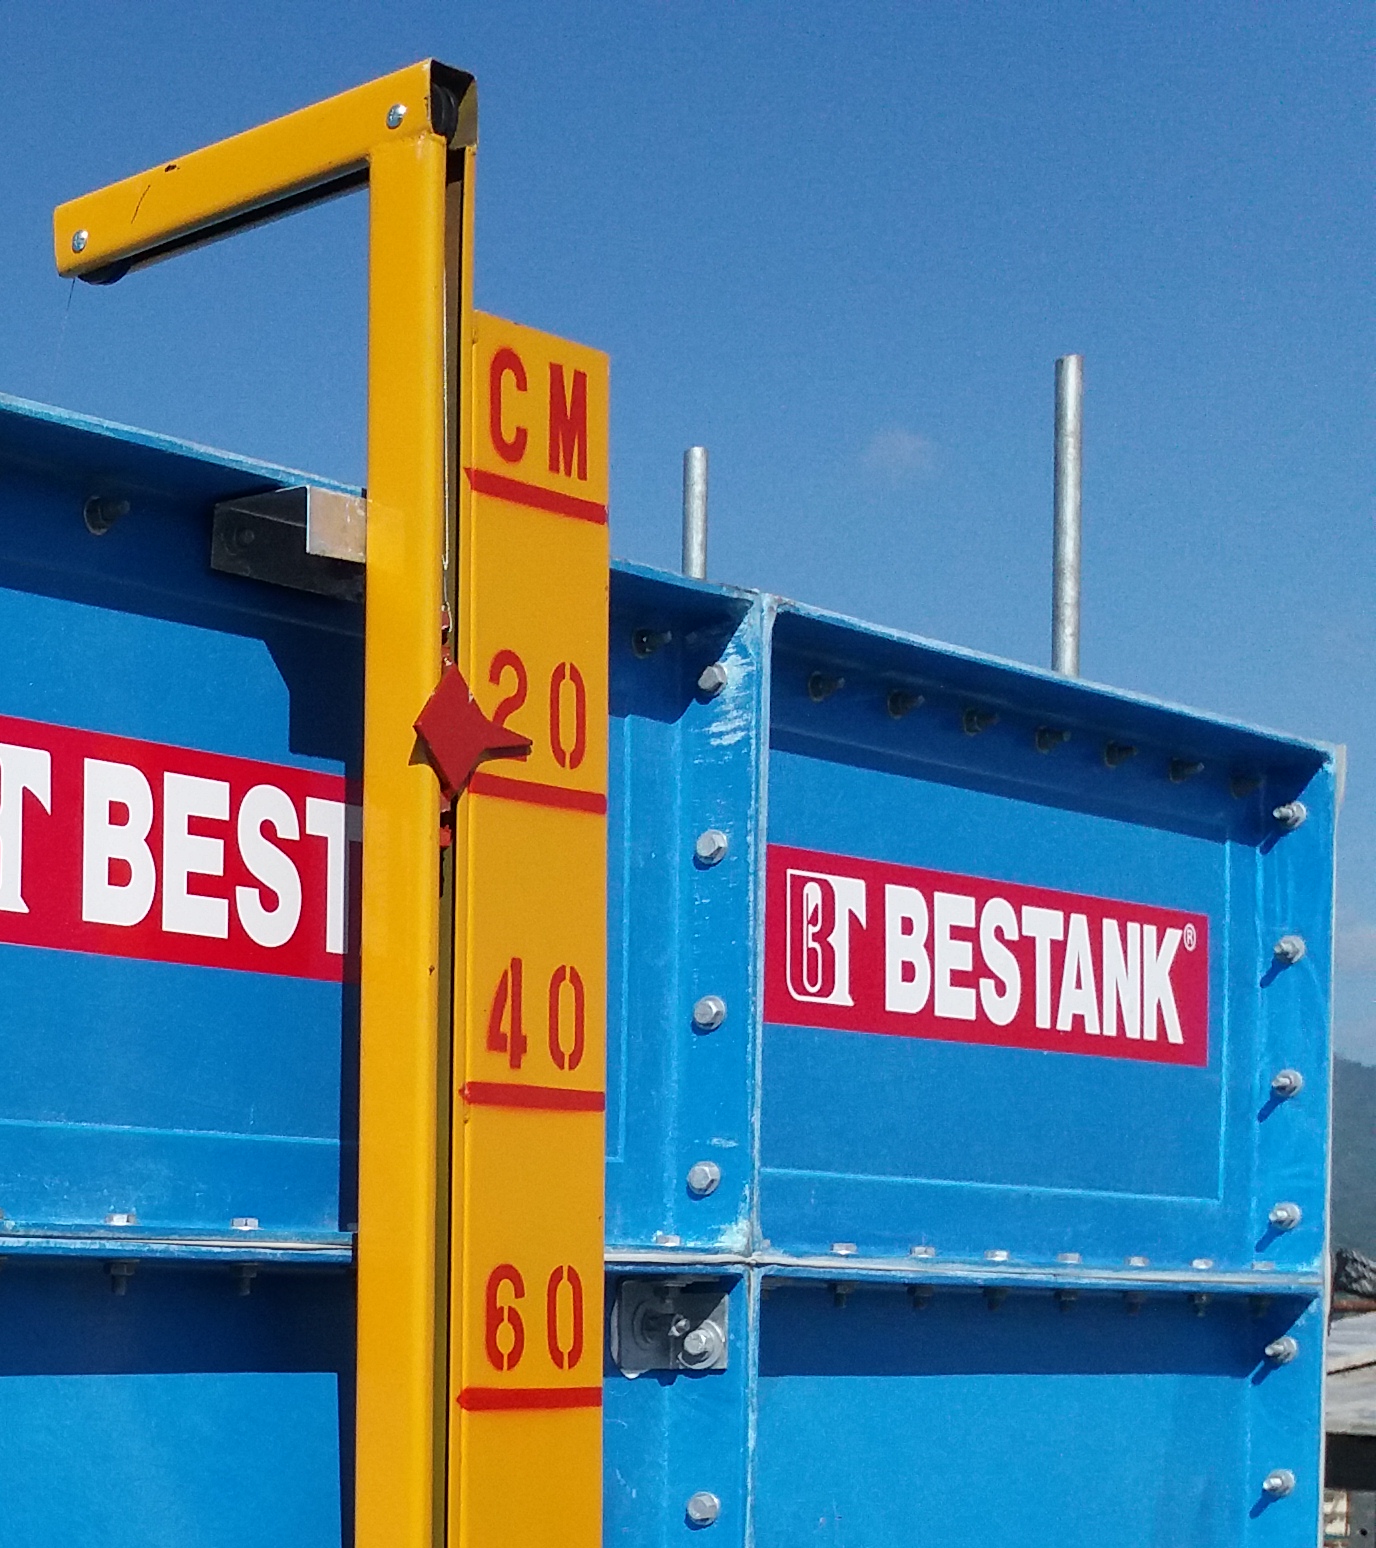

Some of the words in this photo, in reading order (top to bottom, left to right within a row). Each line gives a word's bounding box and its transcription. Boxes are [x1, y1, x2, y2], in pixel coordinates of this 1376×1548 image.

[82, 758, 363, 955] BEST
[487, 957, 586, 1071] 40
[486, 1263, 584, 1372] 60
